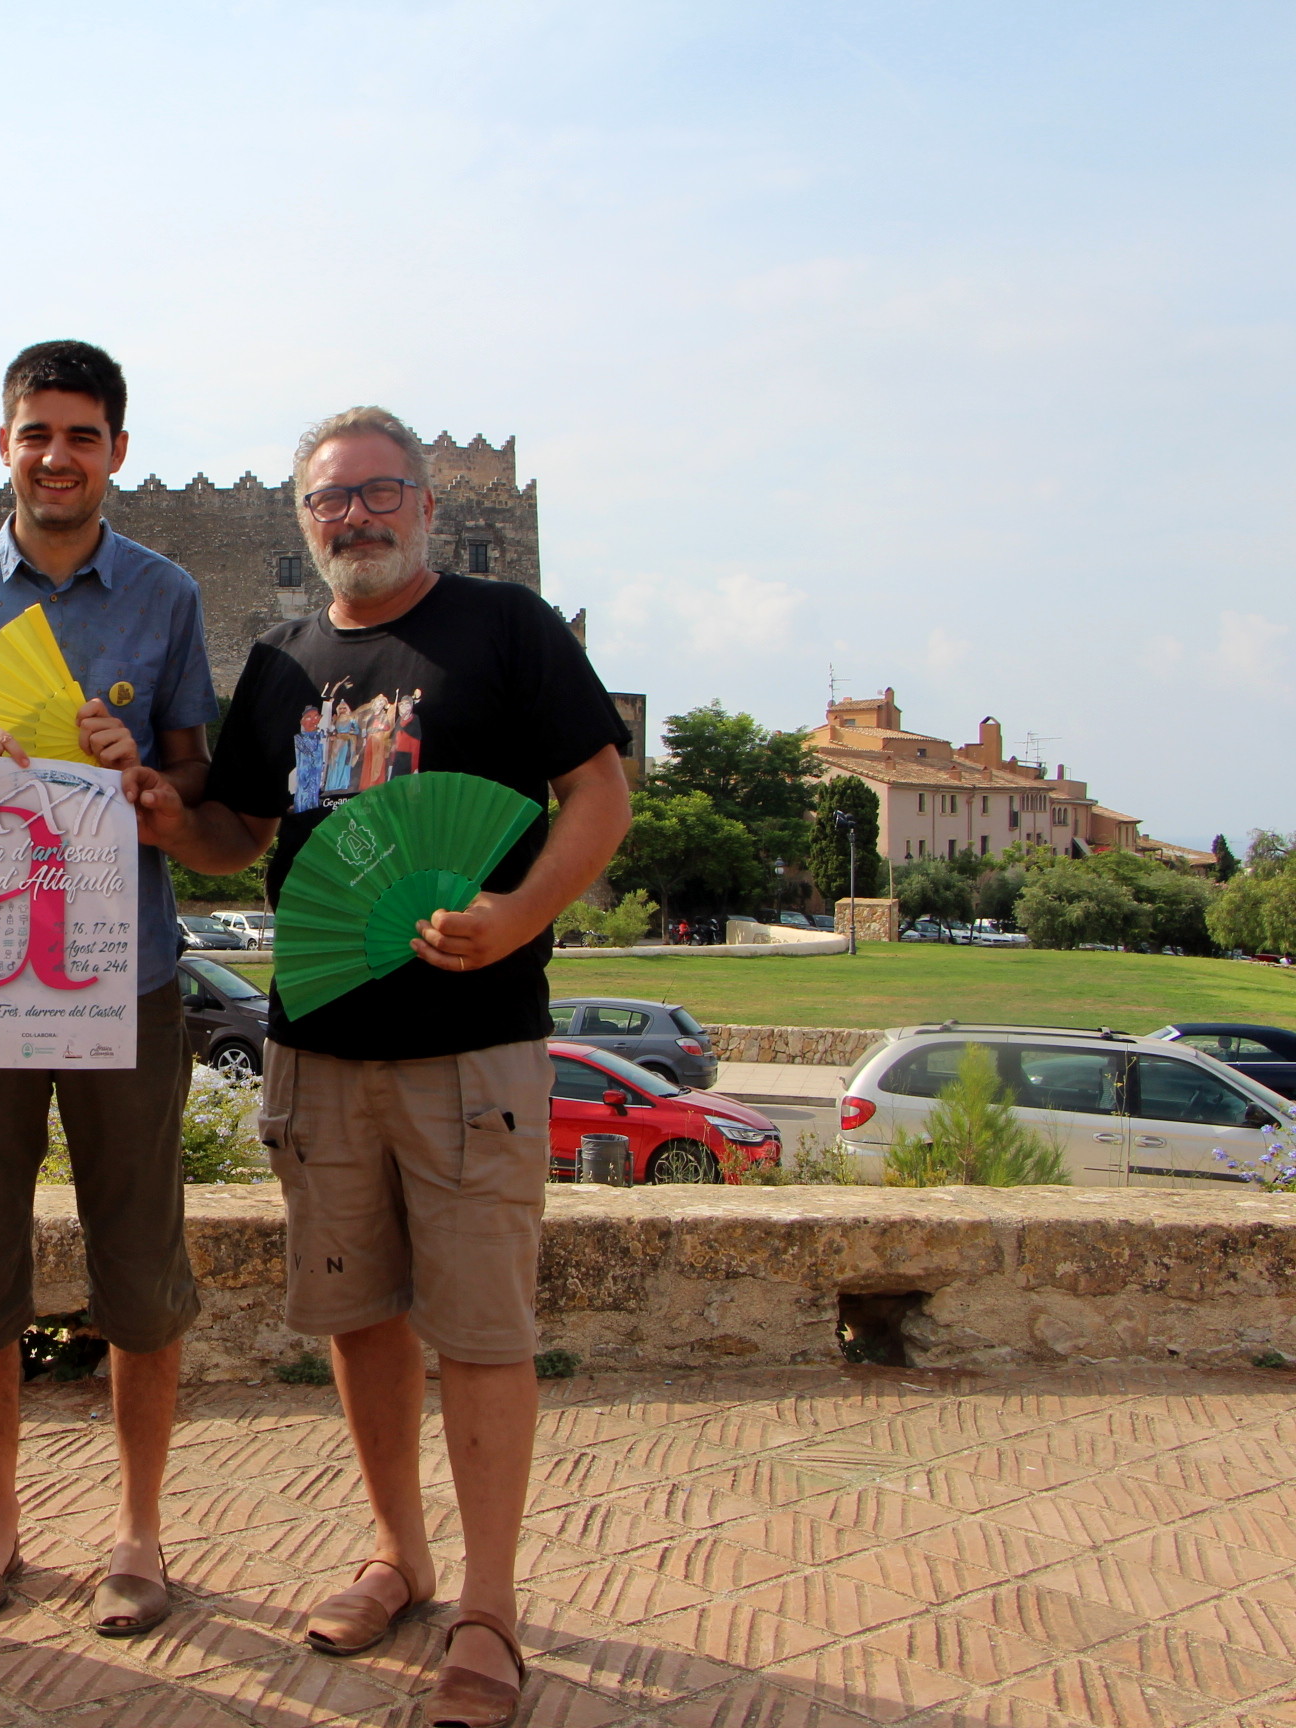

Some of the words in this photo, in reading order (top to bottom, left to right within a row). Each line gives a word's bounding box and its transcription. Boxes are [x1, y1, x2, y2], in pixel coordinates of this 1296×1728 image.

[323, 797, 351, 811] Gegan
[12, 837, 118, 863] d'artesans
[93, 922, 107, 935] 17
[98, 941, 128, 954] 2019
[92, 964, 100, 973] a
[103, 959, 128, 973] 24h
[25, 1005, 66, 1017] darrere
[68, 1005, 87, 1017] del
[89, 1004, 127, 1021] Castell
